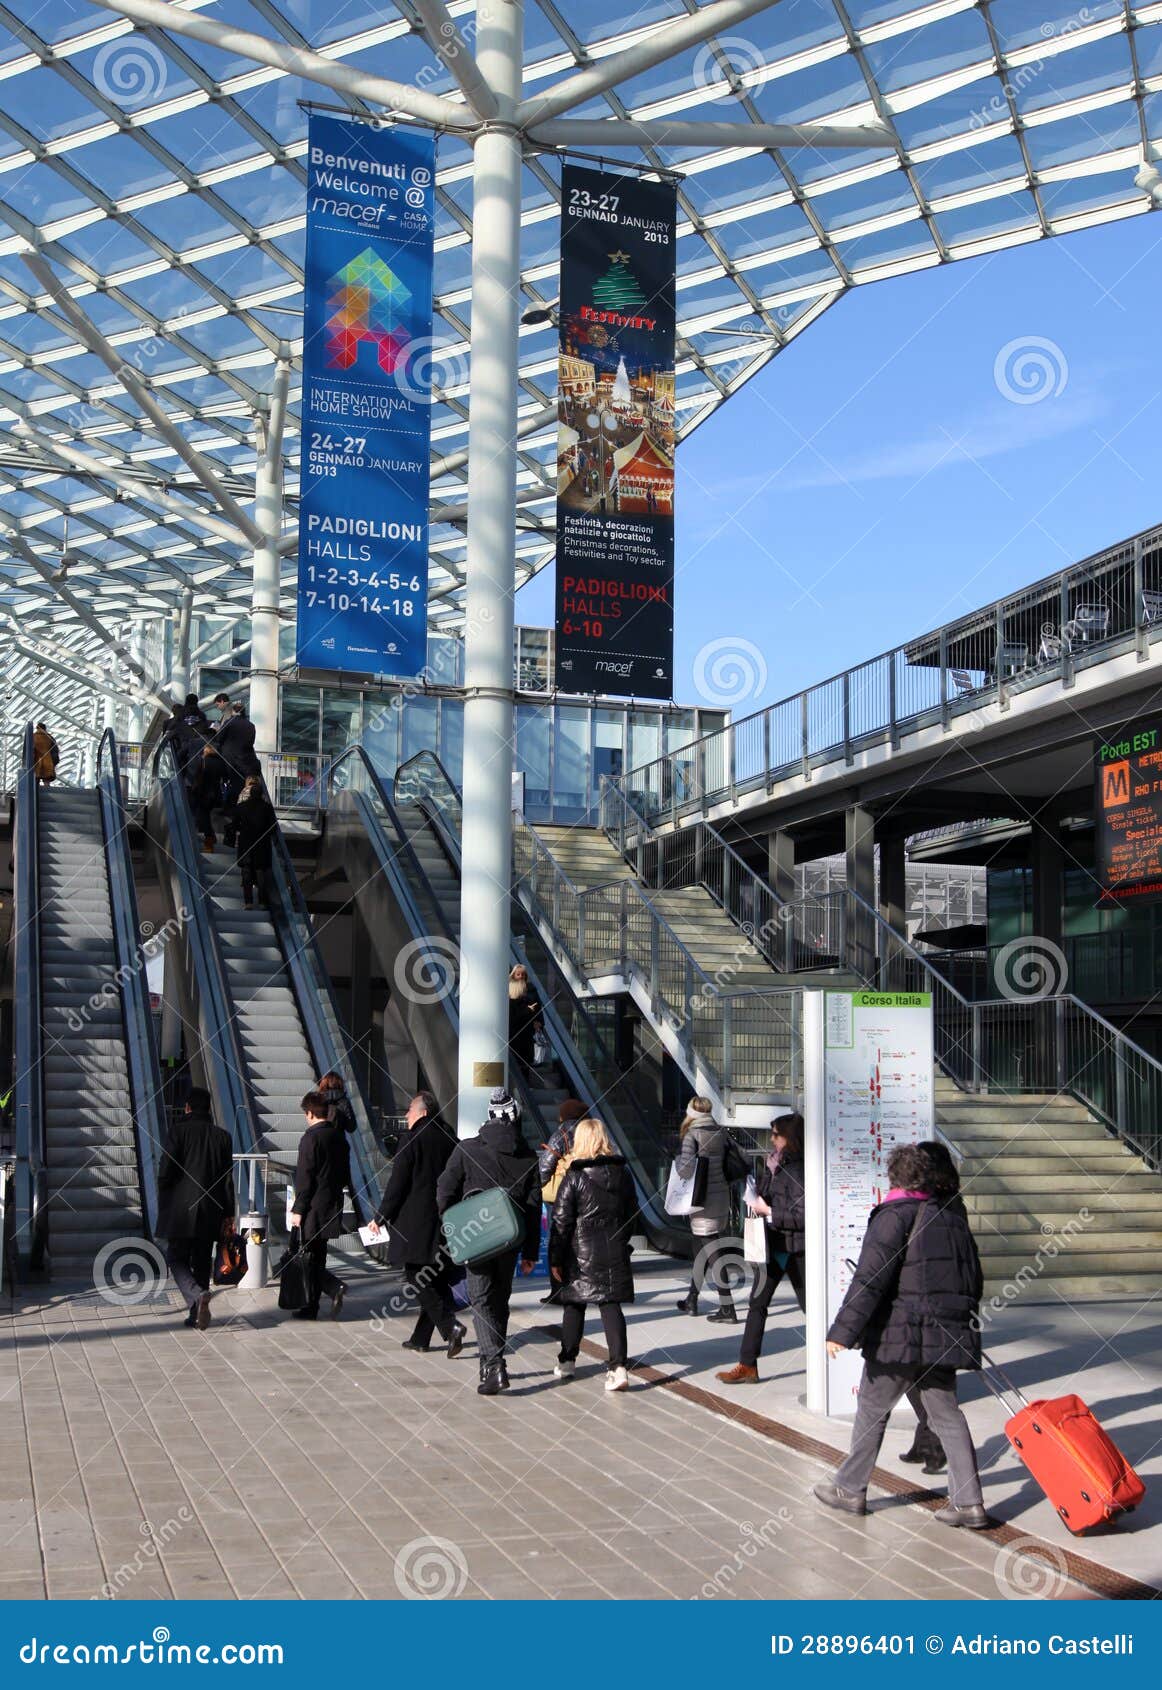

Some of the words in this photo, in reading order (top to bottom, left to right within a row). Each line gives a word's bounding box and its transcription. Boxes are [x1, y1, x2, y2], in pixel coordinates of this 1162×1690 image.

[311, 147, 406, 180] Benvenuti
[411, 167, 431, 188] @
[315, 170, 399, 200] Welcome
[405, 187, 425, 208] @
[312, 197, 387, 223] macef
[570, 188, 620, 212] 23-27
[400, 220, 427, 231] HOME
[404, 211, 429, 223] CASA
[568, 205, 618, 223] GENNAIO
[620, 215, 671, 233] JANUARY
[644, 231, 669, 245] 2013
[310, 401, 348, 415] HOME
[352, 405, 392, 420] SHOW
[311, 388, 416, 412] INTERNATIONAL
[311, 433, 366, 454] 24-27
[308, 464, 337, 477] 2013
[309, 451, 364, 467] GENNAIO
[367, 457, 423, 473] JANUARY
[308, 514, 421, 542] PADIGLIONI
[564, 516, 604, 529] Festività,
[606, 520, 654, 534] decorazioni
[564, 526, 600, 537] natalizie
[610, 530, 651, 543] giocattolo
[307, 539, 371, 562] HALLS
[564, 537, 607, 549] Christmas
[609, 541, 659, 556] decorations,
[564, 546, 606, 559] Festivities
[607, 552, 623, 561] and
[625, 553, 638, 564] Toy
[640, 556, 666, 567] sector
[307, 565, 420, 592] 1-2-3-4-5-6
[563, 576, 667, 602] PADIGLIONI
[306, 591, 414, 617] 7-10-14-18
[563, 597, 622, 618] HALLS
[562, 619, 602, 638] 6-10
[595, 661, 634, 673] macef
[1101, 741, 1131, 761] Porta
[1133, 730, 1157, 752] EST
[1106, 768, 1128, 800] M
[861, 994, 892, 1006] Corso
[895, 994, 921, 1006] Italia
